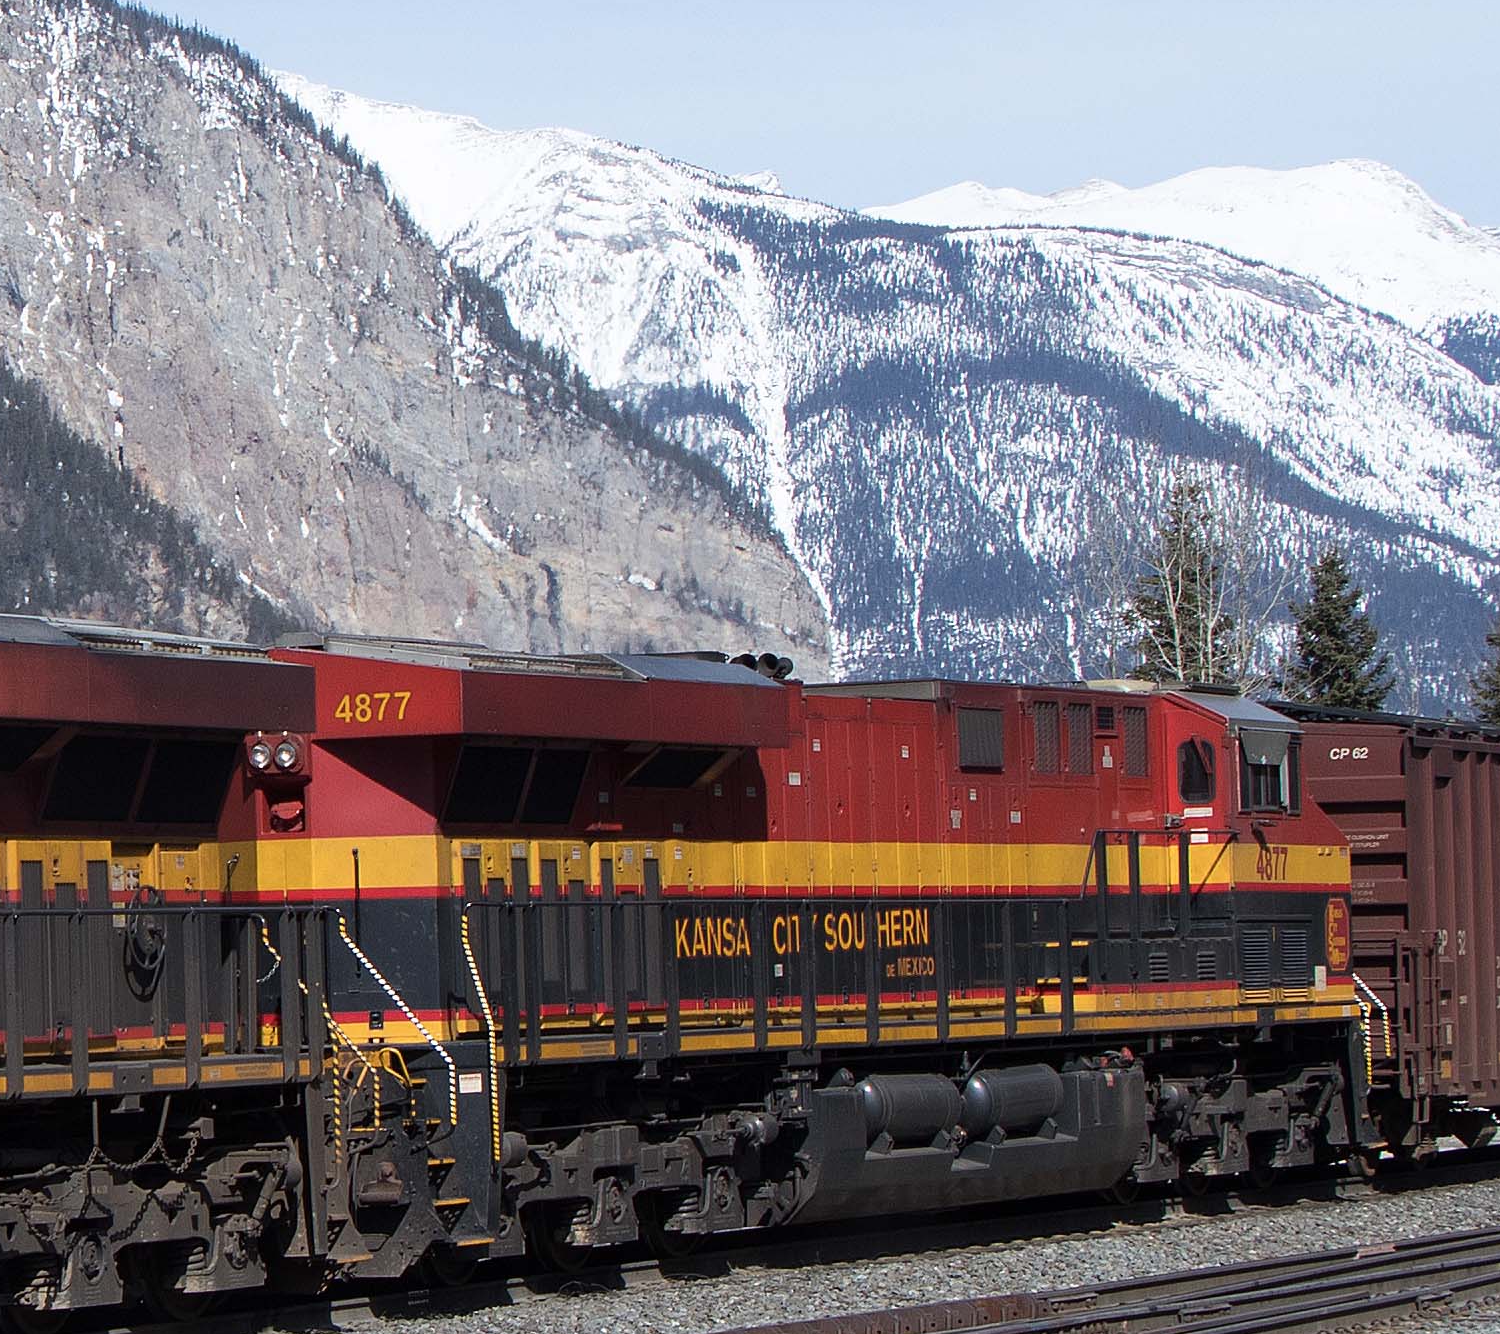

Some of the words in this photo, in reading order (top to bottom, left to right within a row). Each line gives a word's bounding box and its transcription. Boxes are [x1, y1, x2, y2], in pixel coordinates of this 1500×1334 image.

[334, 691, 412, 723] 4877
[1330, 747, 1350, 760] CP
[1352, 747, 1369, 759] 62
[1256, 846, 1288, 881] 4877
[675, 917, 752, 958] KANSA
[772, 914, 818, 955] CIT
[824, 908, 929, 952] SOUHERN
[897, 956, 936, 977] MEXICO
